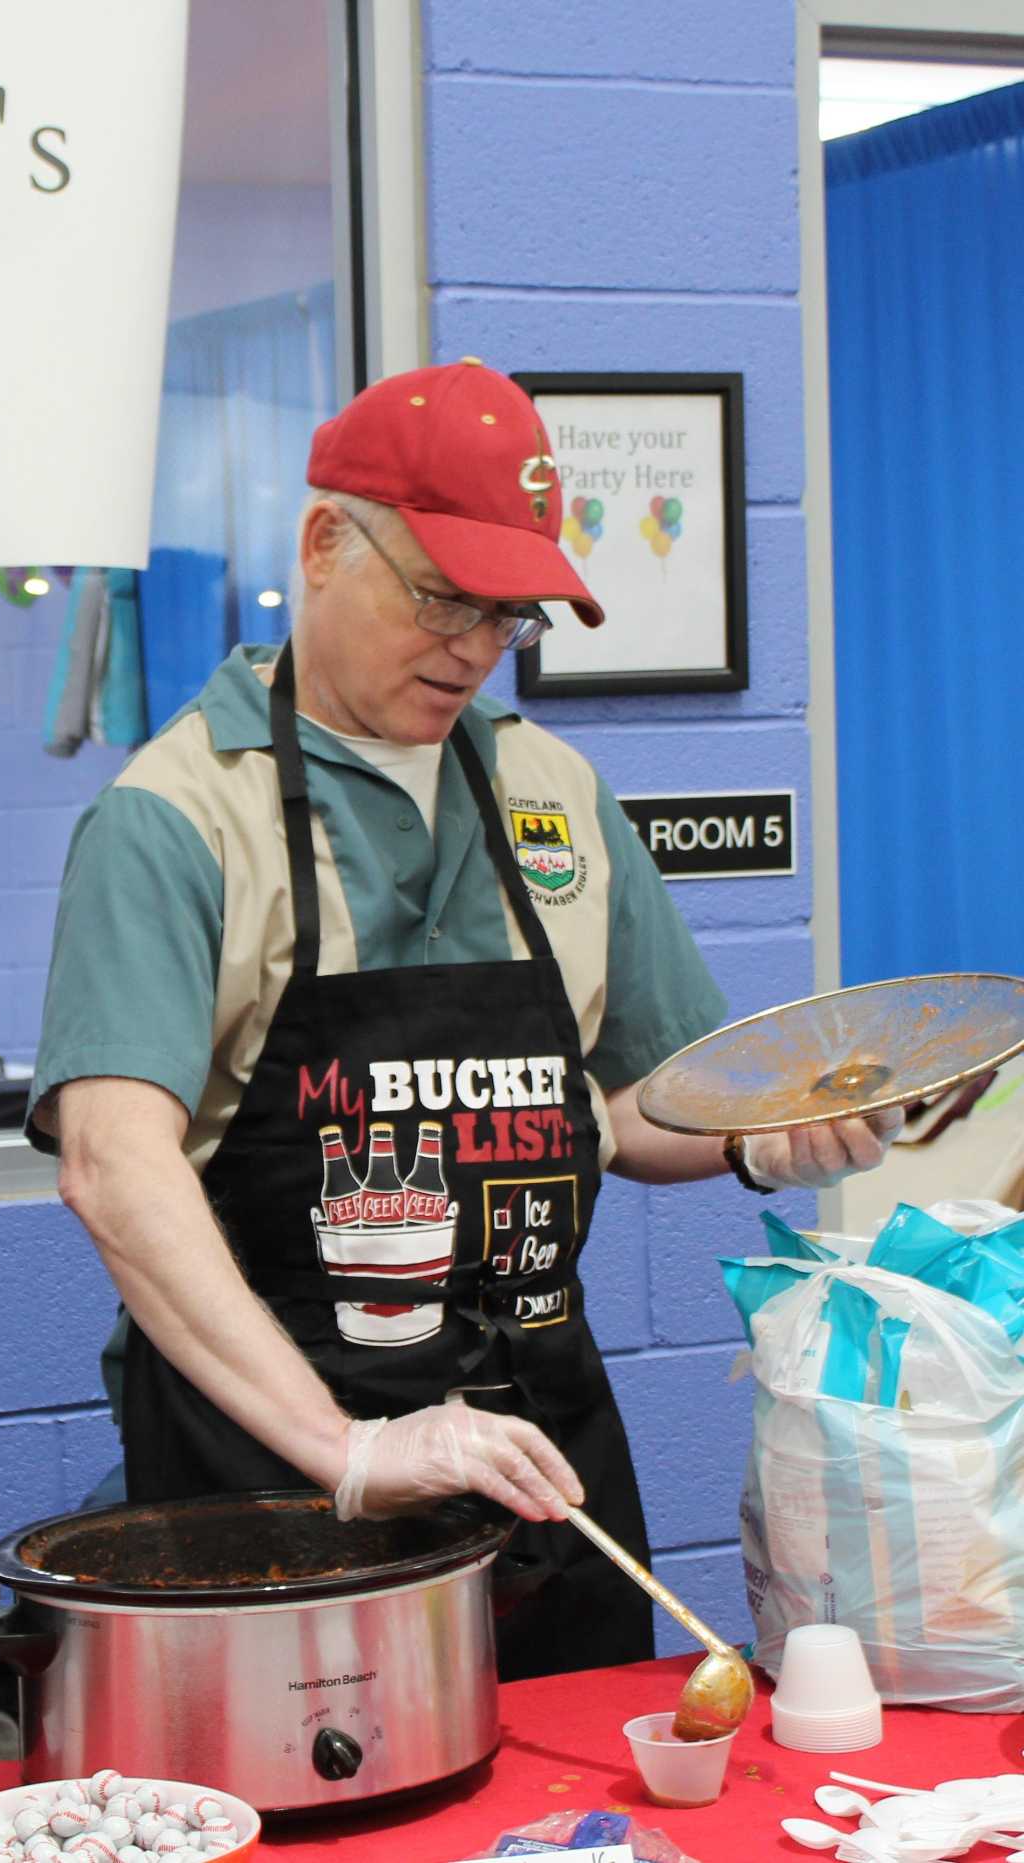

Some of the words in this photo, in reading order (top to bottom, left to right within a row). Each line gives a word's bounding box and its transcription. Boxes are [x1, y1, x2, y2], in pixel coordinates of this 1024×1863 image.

[557, 424, 621, 449] Have
[627, 429, 688, 456] your
[559, 464, 625, 495] Party
[635, 464, 694, 489] Here
[508, 797, 563, 810] CLEVELAND
[650, 815, 755, 851] ROOM
[763, 815, 784, 848] 5
[527, 888, 578, 906] CHWABEN
[298, 1058, 365, 1155] My
[369, 1056, 566, 1112] BUCKET
[364, 1195, 402, 1220] BEER
[407, 1193, 444, 1216] BEER
[525, 1190, 552, 1228] Ice
[288, 1678, 341, 1691] Hamilton
[342, 1670, 377, 1684] Beach
